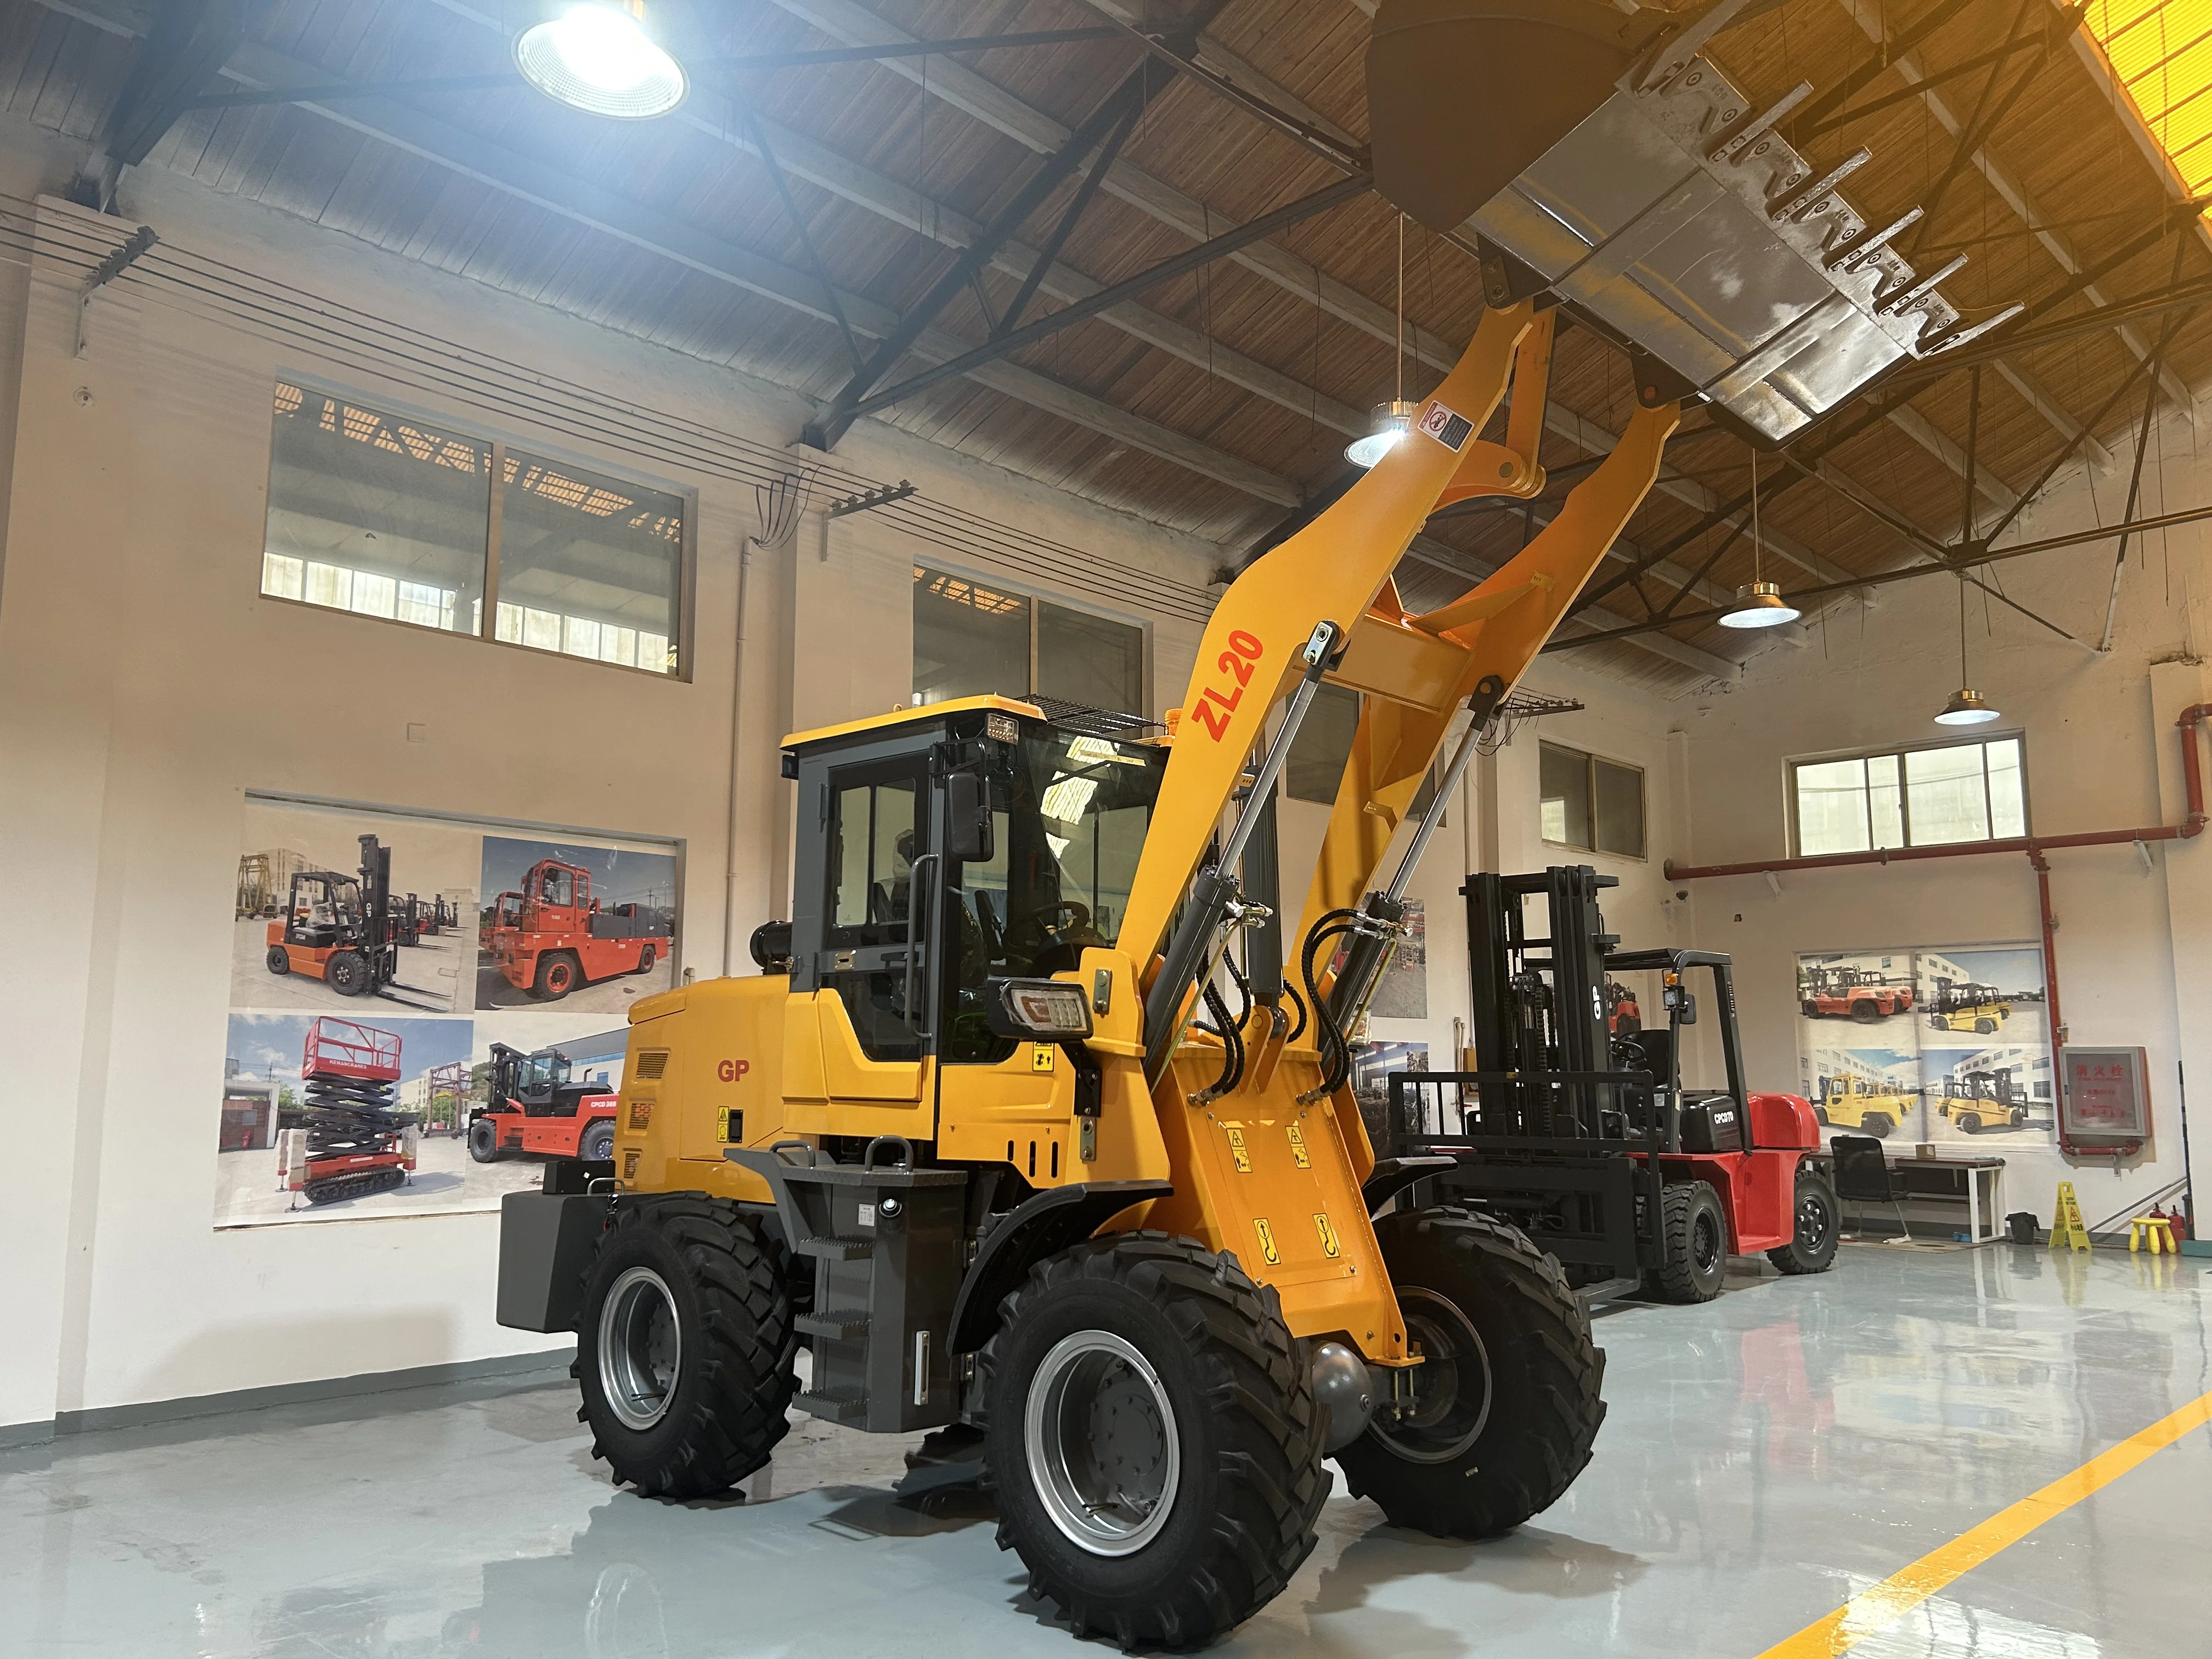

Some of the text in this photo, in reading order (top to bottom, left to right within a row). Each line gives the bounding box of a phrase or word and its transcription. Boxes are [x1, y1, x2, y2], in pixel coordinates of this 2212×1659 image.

[1191, 630, 1263, 743] ZL20
[1593, 985, 1601, 1020] GP
[718, 1059, 749, 1082] GP
[1714, 1110, 1734, 1125] CPCD70
